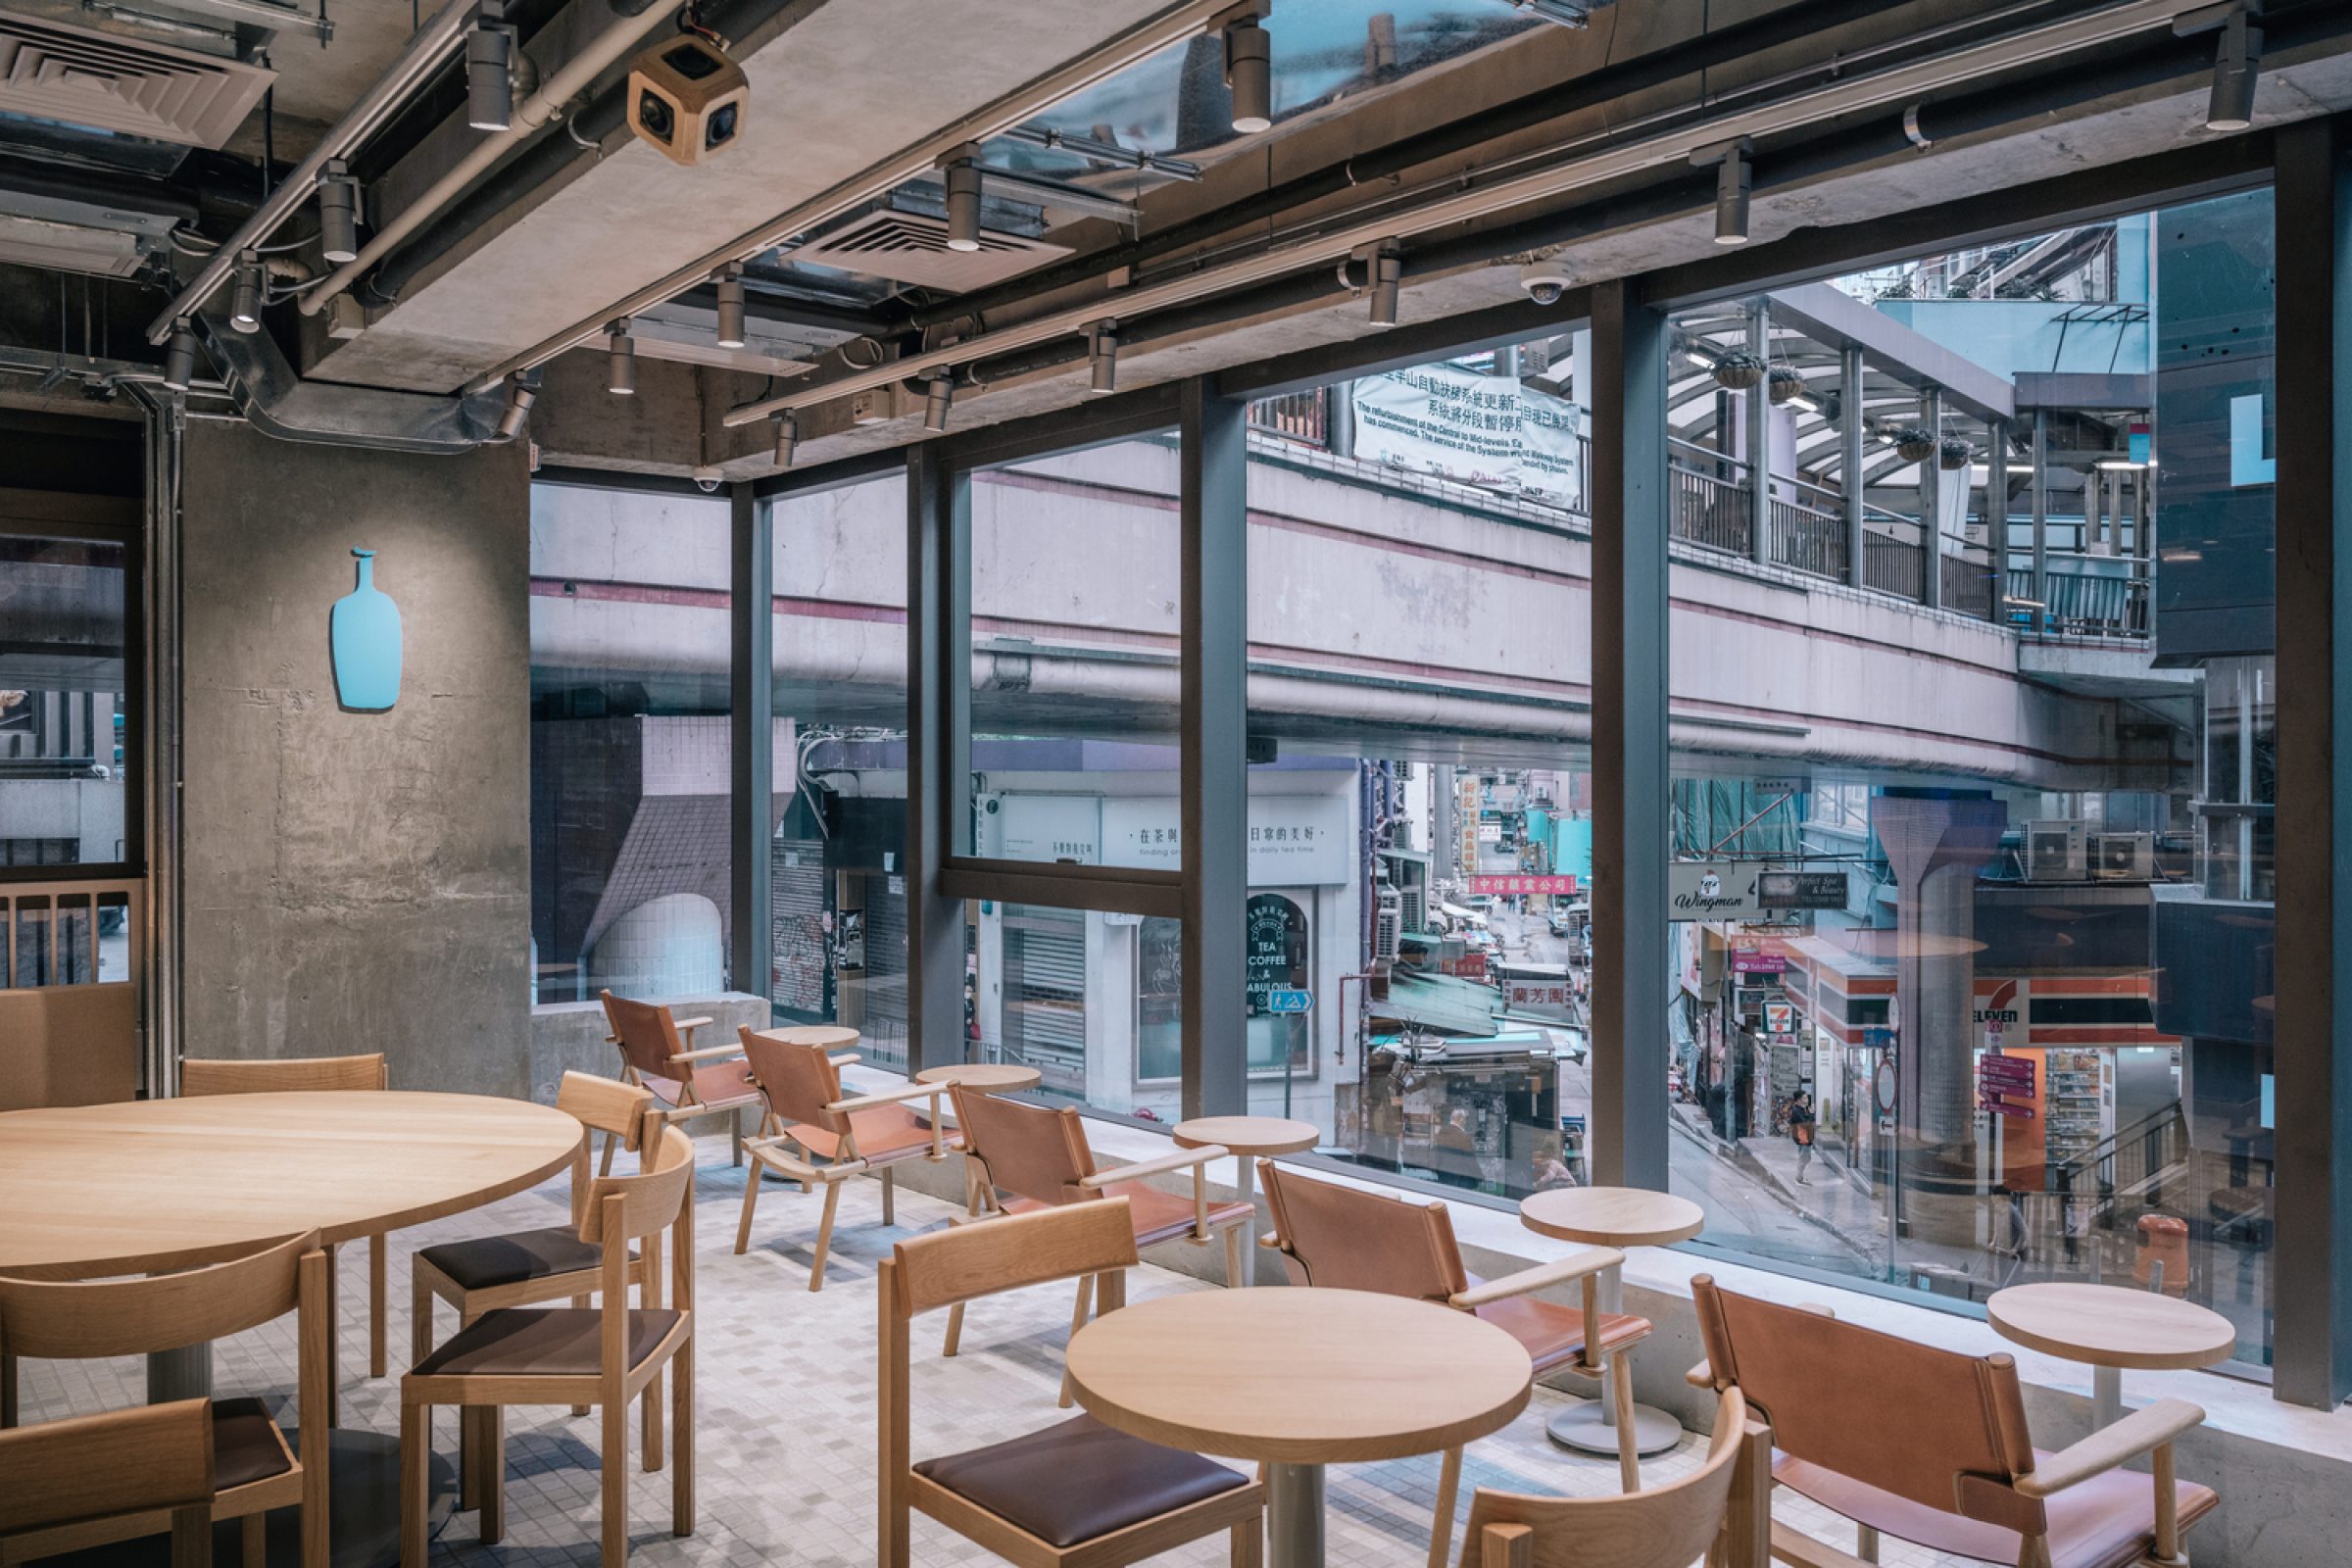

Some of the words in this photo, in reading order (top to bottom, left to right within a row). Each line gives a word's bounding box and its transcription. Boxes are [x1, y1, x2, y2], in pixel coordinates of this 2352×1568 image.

[1357, 400, 1371, 413] The
[1421, 430, 1434, 442] The
[1674, 890, 1743, 912] Wingman
[1258, 942, 1277, 954] TEA
[1248, 956, 1287, 966] COFFEE
[1247, 982, 1294, 994] ABULOUS
